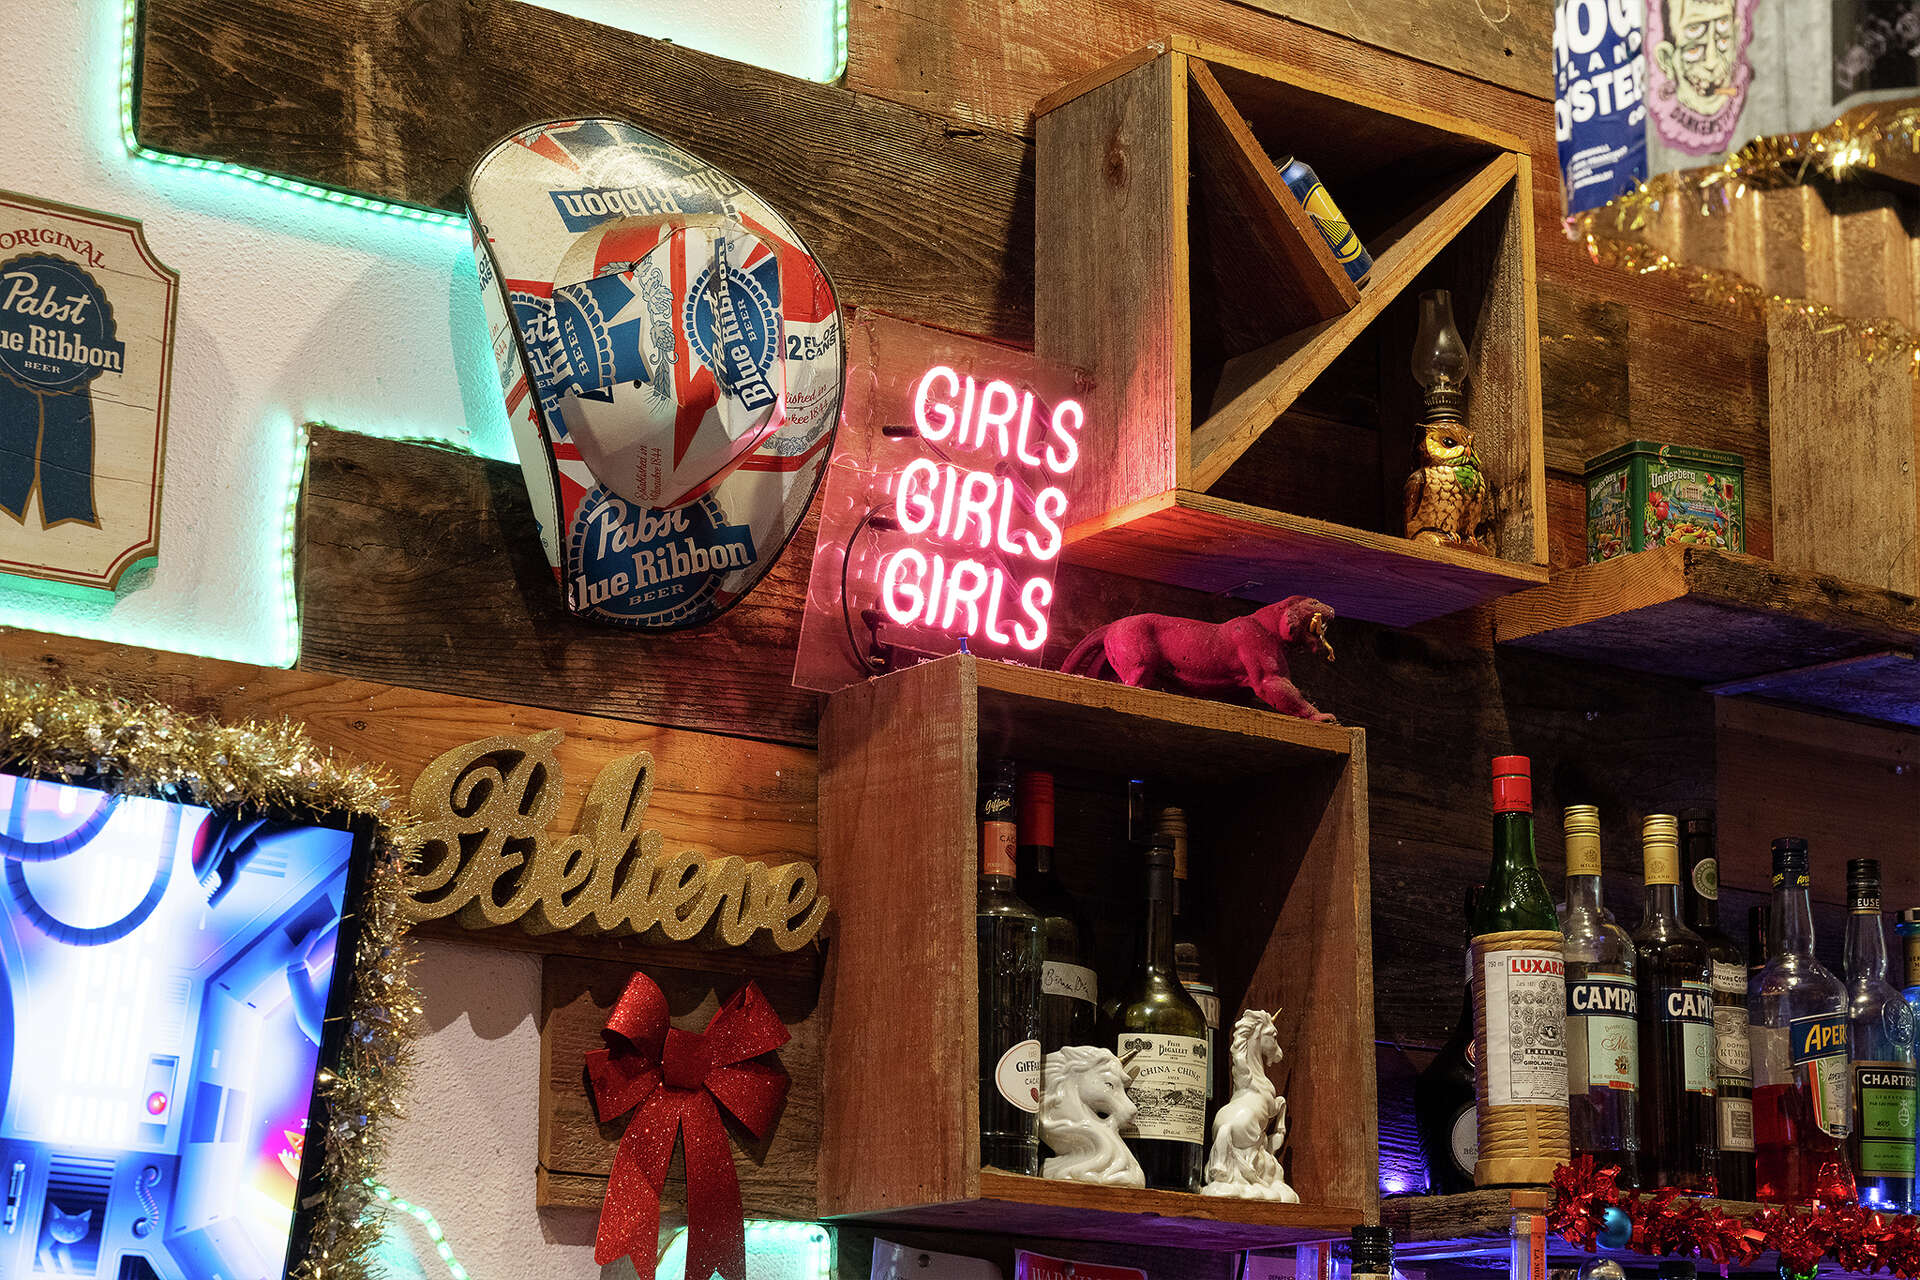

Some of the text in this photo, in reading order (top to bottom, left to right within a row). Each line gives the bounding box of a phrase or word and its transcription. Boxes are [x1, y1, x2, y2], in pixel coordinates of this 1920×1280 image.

[0, 228, 106, 269] ORIGINAL
[3, 271, 92, 325] Pabst
[714, 243, 777, 406] Blue Ribbon
[739, 298, 757, 343] BEER
[23, 360, 62, 375] BEER
[27, 323, 122, 371] Ribbon
[563, 316, 590, 377] BEER
[914, 366, 1084, 474] GIRLS
[1650, 468, 1697, 489] Underberg
[586, 497, 691, 561] Pabst
[895, 458, 1068, 561] GIRLS
[566, 540, 752, 613] lue Ribbon
[627, 584, 686, 607] BEER
[882, 548, 1054, 650] GIRLS
[400, 729, 830, 953] Believe
[1857, 898, 1880, 909] EUSE
[1140, 1066, 1171, 1078] CHINA
